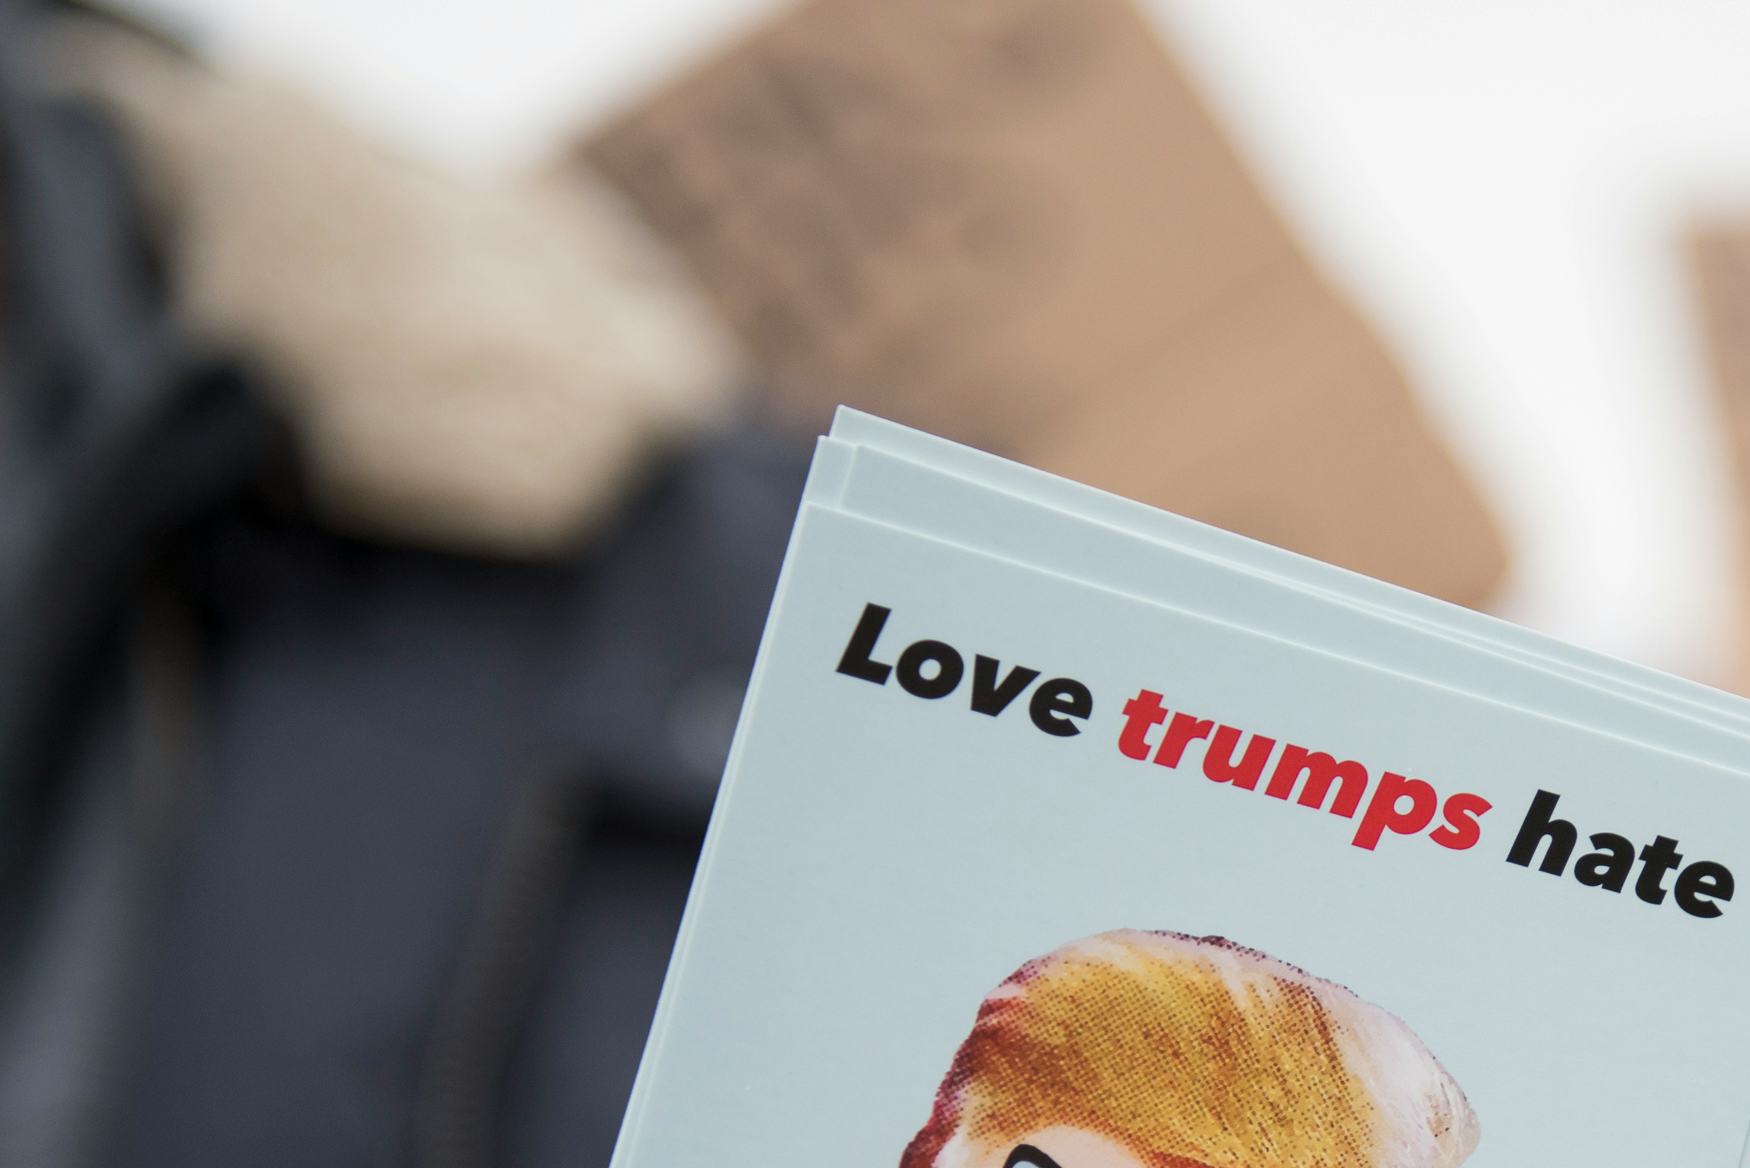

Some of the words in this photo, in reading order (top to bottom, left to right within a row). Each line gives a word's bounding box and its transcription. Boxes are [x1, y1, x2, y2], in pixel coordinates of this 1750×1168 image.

[835, 602, 1093, 738] Love
[1118, 689, 1493, 851] trumps
[1505, 789, 1735, 919] hate
